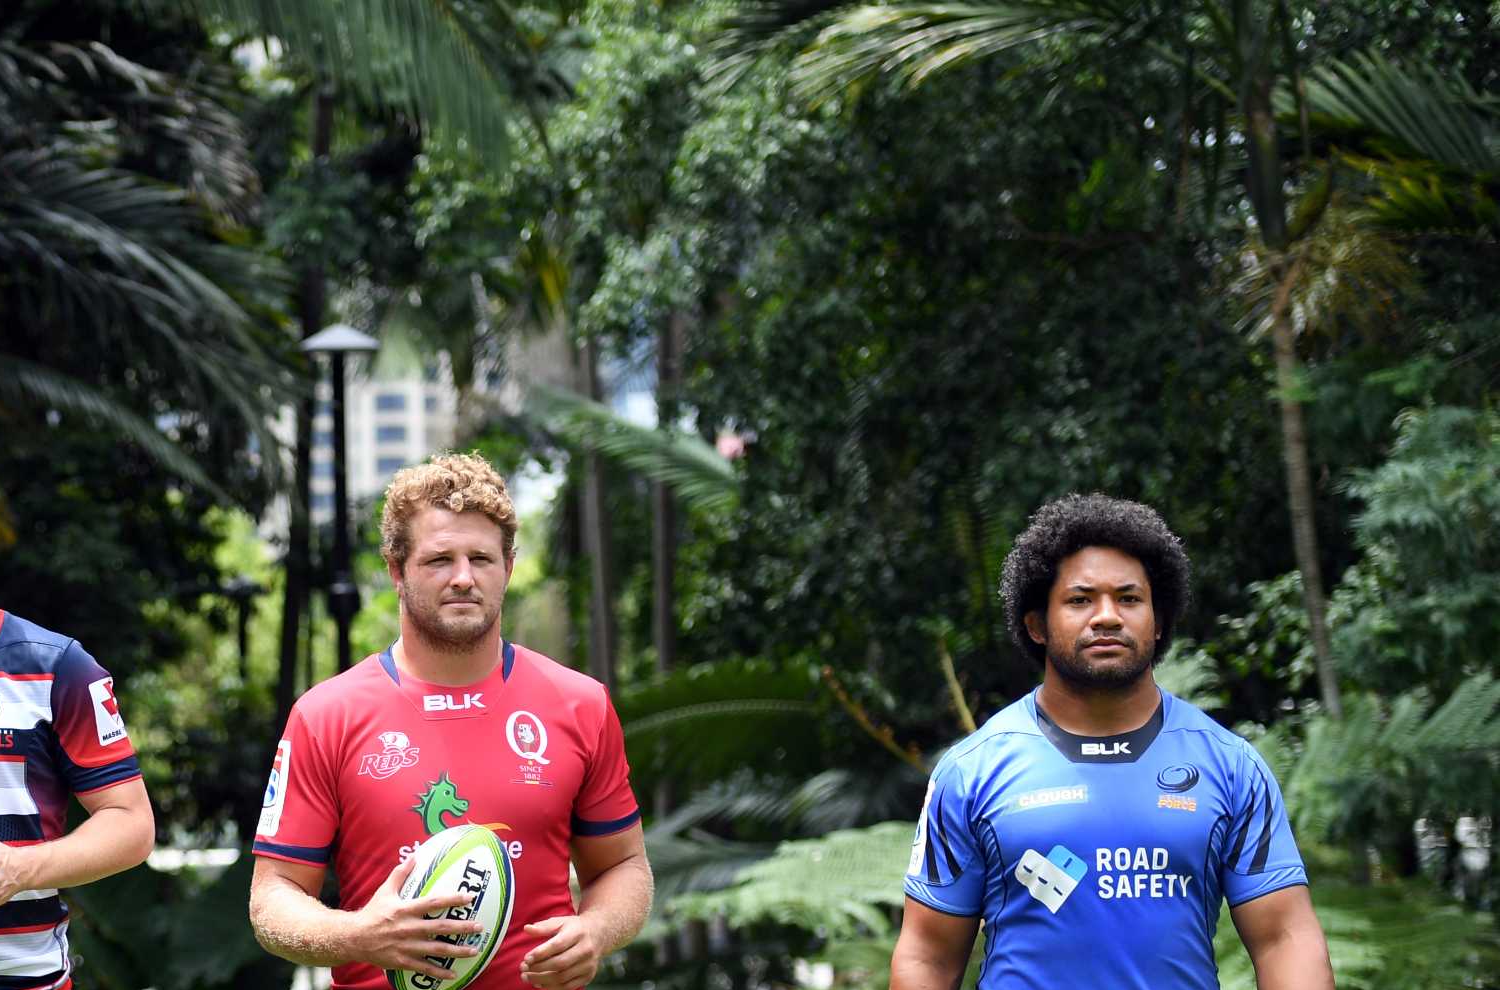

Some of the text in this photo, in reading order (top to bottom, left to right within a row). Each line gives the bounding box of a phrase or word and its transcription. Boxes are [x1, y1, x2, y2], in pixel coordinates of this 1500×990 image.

[423, 693, 486, 712] BLK
[1081, 742, 1132, 755] BLK
[357, 747, 420, 779] REDS
[519, 765, 544, 773] SINCE
[1019, 788, 1084, 807] CLOUGH
[1096, 847, 1169, 872] ROAD
[1098, 874, 1192, 899] SAFETY
